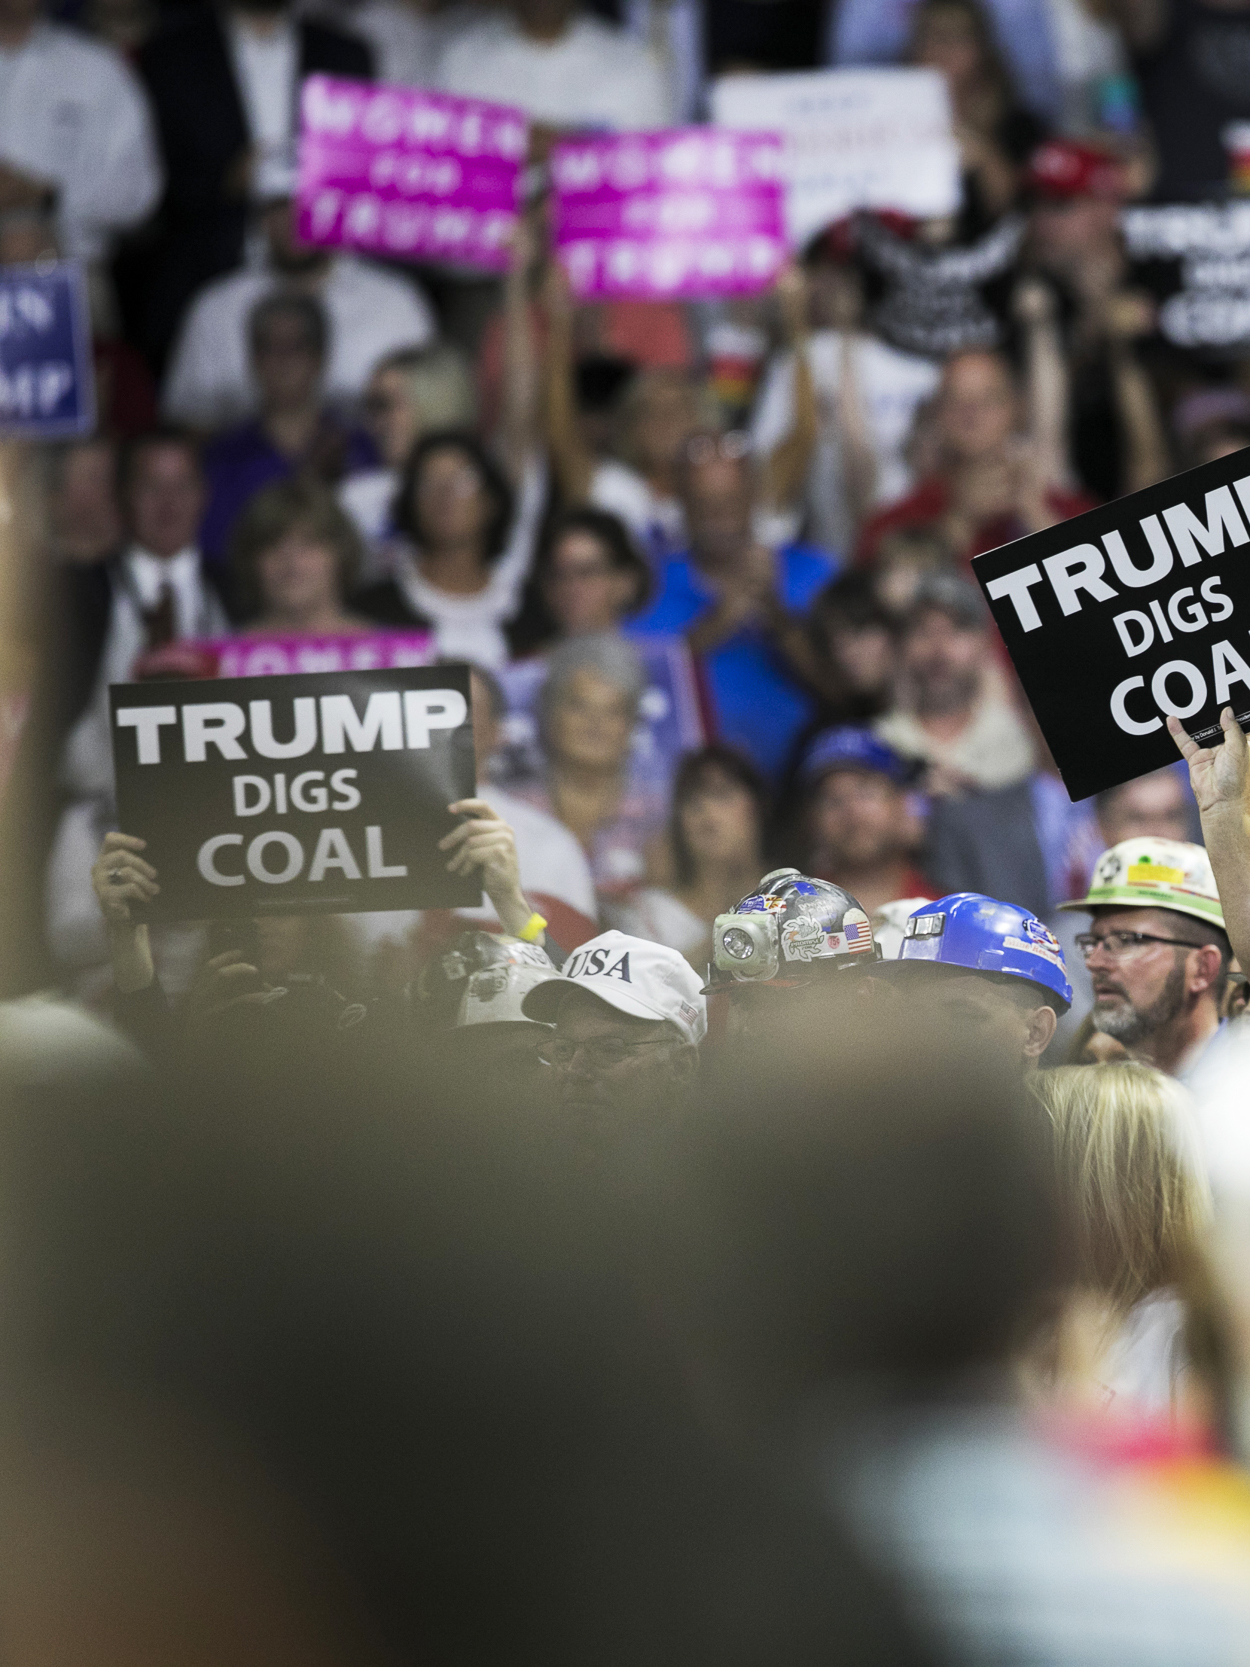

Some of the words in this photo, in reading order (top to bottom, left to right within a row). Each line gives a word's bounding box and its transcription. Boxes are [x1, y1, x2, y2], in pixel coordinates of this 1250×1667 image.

[303, 80, 528, 160] WOMEN
[369, 150, 464, 197] FOR
[312, 190, 518, 252] TRUMP
[1112, 575, 1235, 658] DIGS
[116, 689, 468, 765] TRUMP
[233, 768, 362, 817] DIGS
[197, 825, 408, 887] COAL
[566, 948, 633, 984] USA
